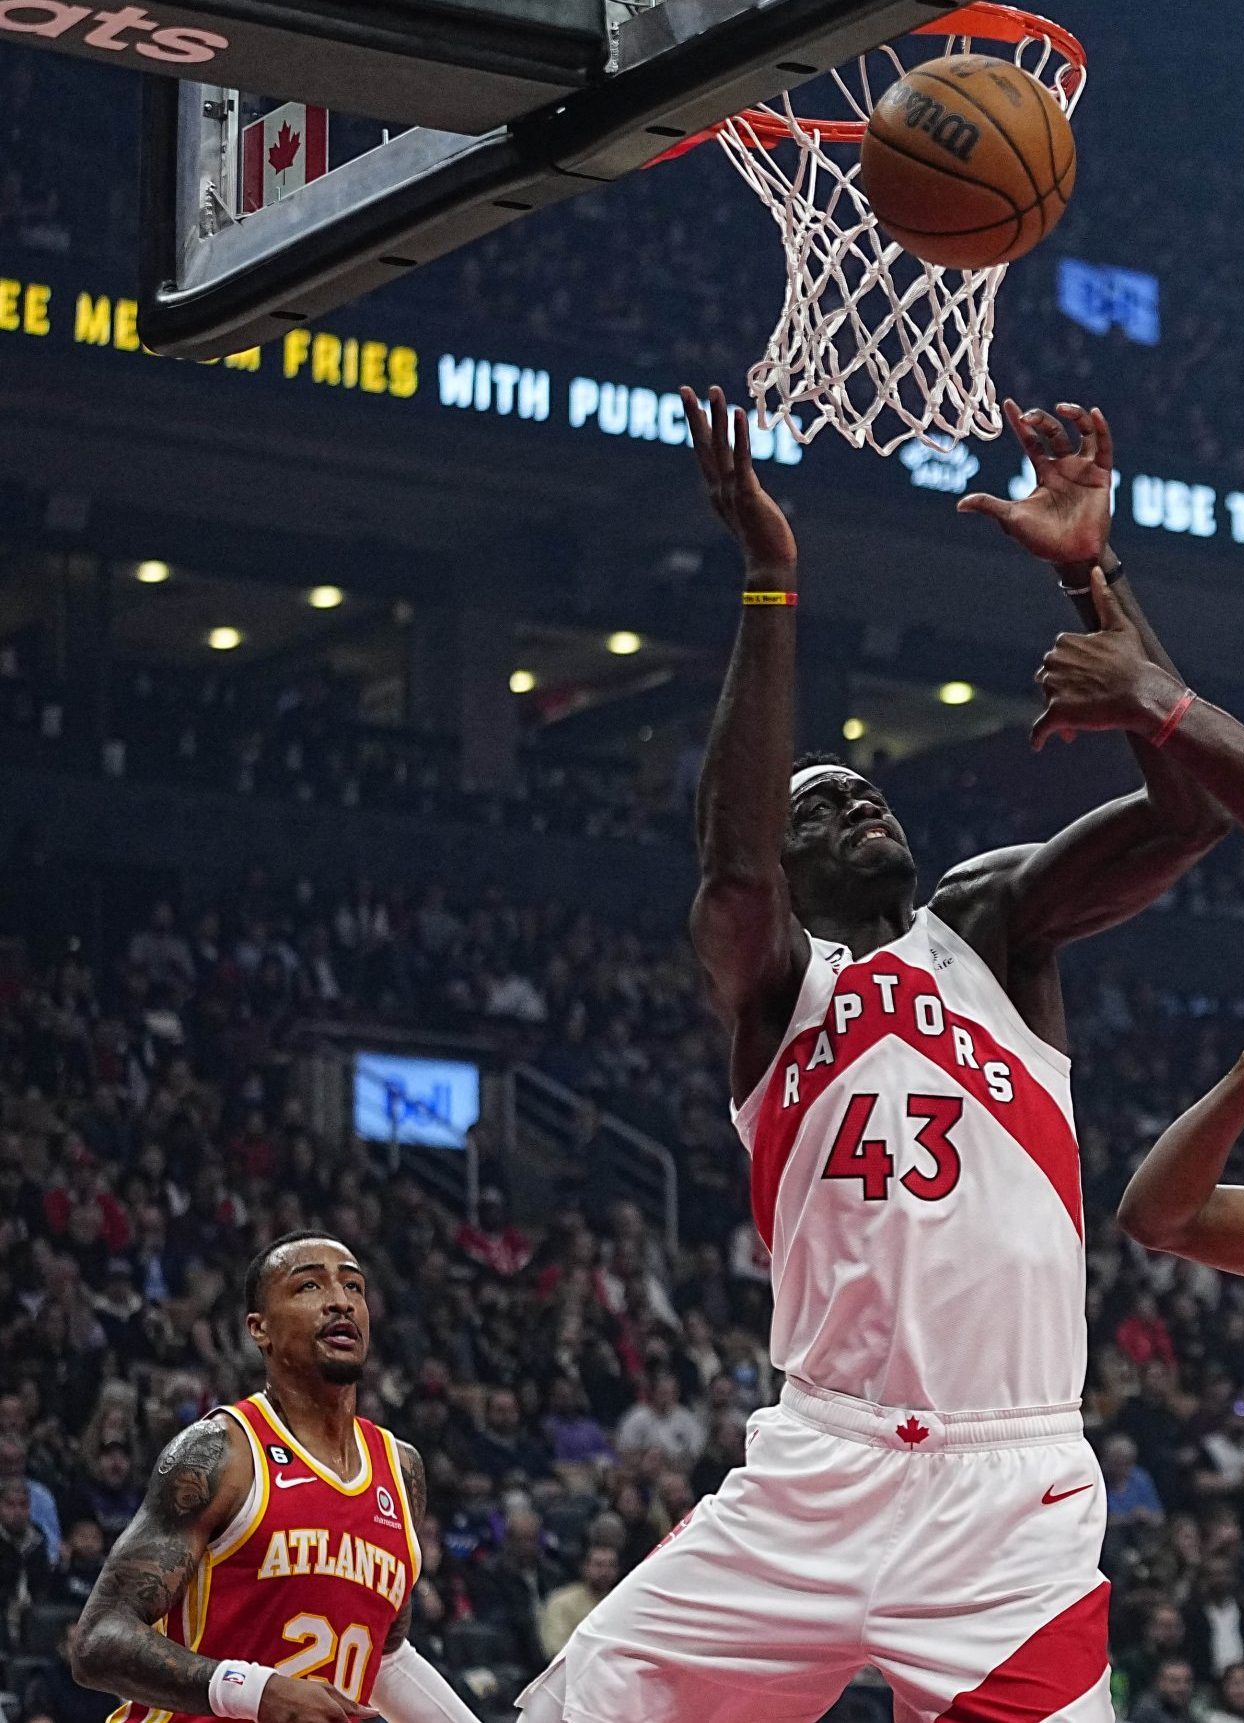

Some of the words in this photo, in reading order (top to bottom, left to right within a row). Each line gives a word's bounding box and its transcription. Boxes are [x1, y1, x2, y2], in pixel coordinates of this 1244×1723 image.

[283, 328, 418, 398] FRIES
[438, 353, 550, 422] WITH
[568, 377, 803, 466] PURCSE
[1132, 474, 1218, 538] USE
[783, 974, 1014, 1109] RAPTORS
[821, 1093, 964, 1201] 43
[270, 1446, 289, 1464] 6
[257, 1528, 406, 1612] ATLANTA
[274, 1612, 374, 1703] 20
